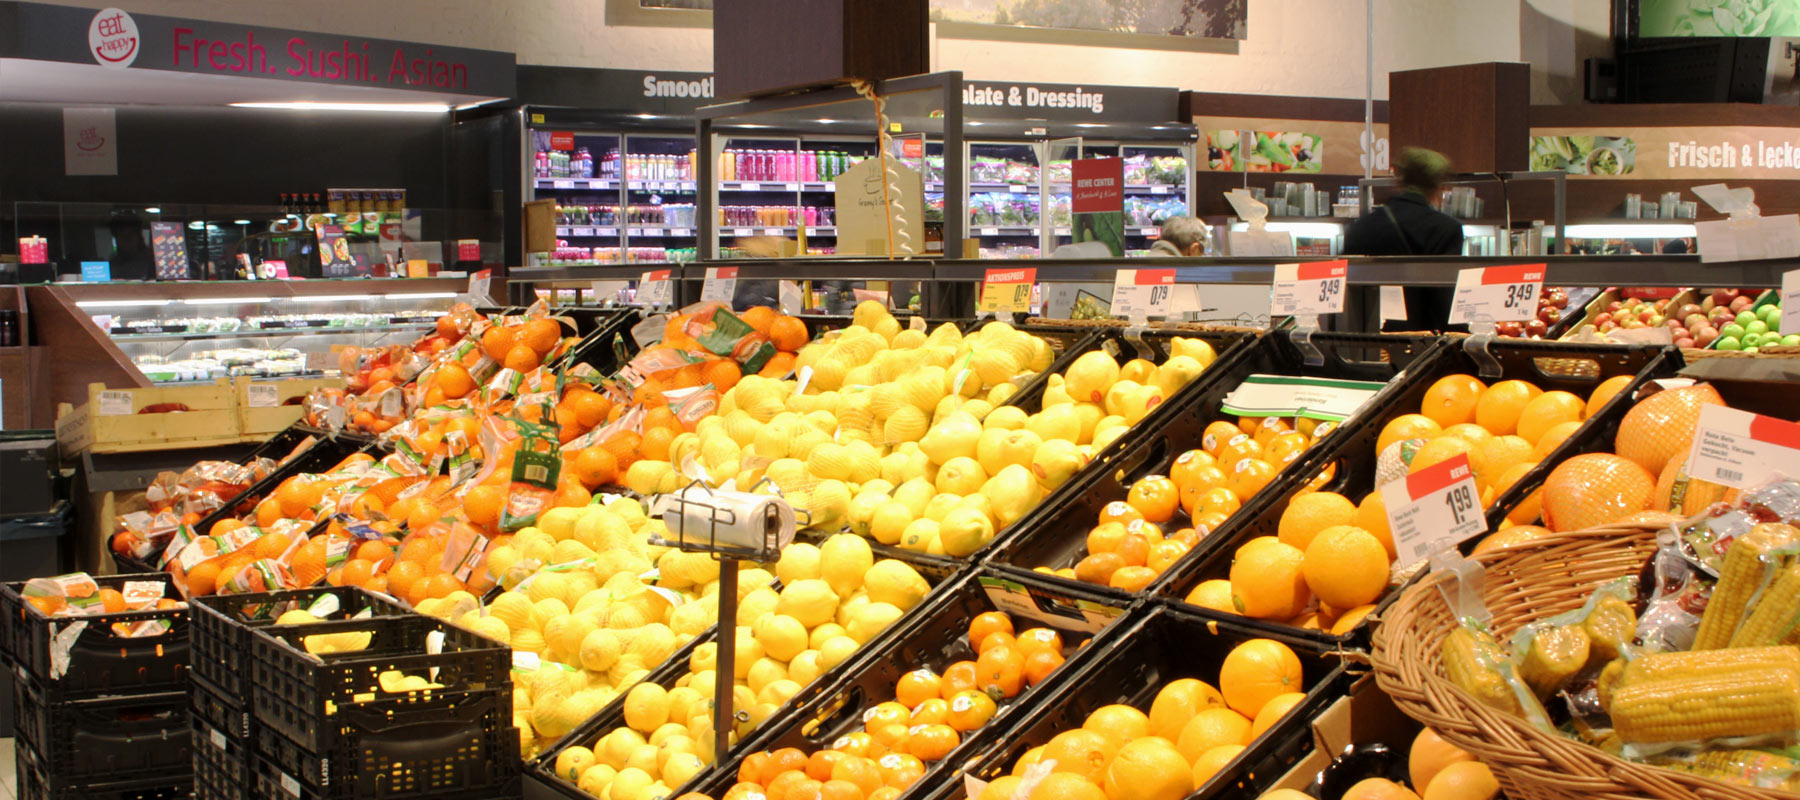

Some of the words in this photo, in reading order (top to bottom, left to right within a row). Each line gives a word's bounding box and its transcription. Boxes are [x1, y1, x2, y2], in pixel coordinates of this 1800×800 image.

[98, 13, 127, 37] eat
[102, 37, 129, 52] happy
[173, 28, 276, 75] Fresh.
[286, 38, 378, 83] Sushi.
[387, 49, 467, 89] Asian
[1008, 86, 1022, 106] &
[1026, 87, 1104, 113] Dressing
[1668, 141, 1736, 168] Frisch
[1741, 144, 1752, 167] &
[1758, 140, 1800, 169] Lecke
[1077, 178, 1093, 188] REWE
[1094, 177, 1115, 187] CENTER
[986, 271, 1024, 283] AKTIONSPREIS
[1330, 267, 1344, 275] REWE
[1523, 272, 1542, 281] REWE
[1014, 284, 1030, 303] 0.79
[1150, 286, 1168, 305] 0.79
[1319, 279, 1340, 302] 3.49
[1504, 284, 1534, 308] 3.49
[1449, 463, 1470, 479] REWE
[1445, 484, 1473, 525] 1.99
[321, 758, 330, 786] LL4320
